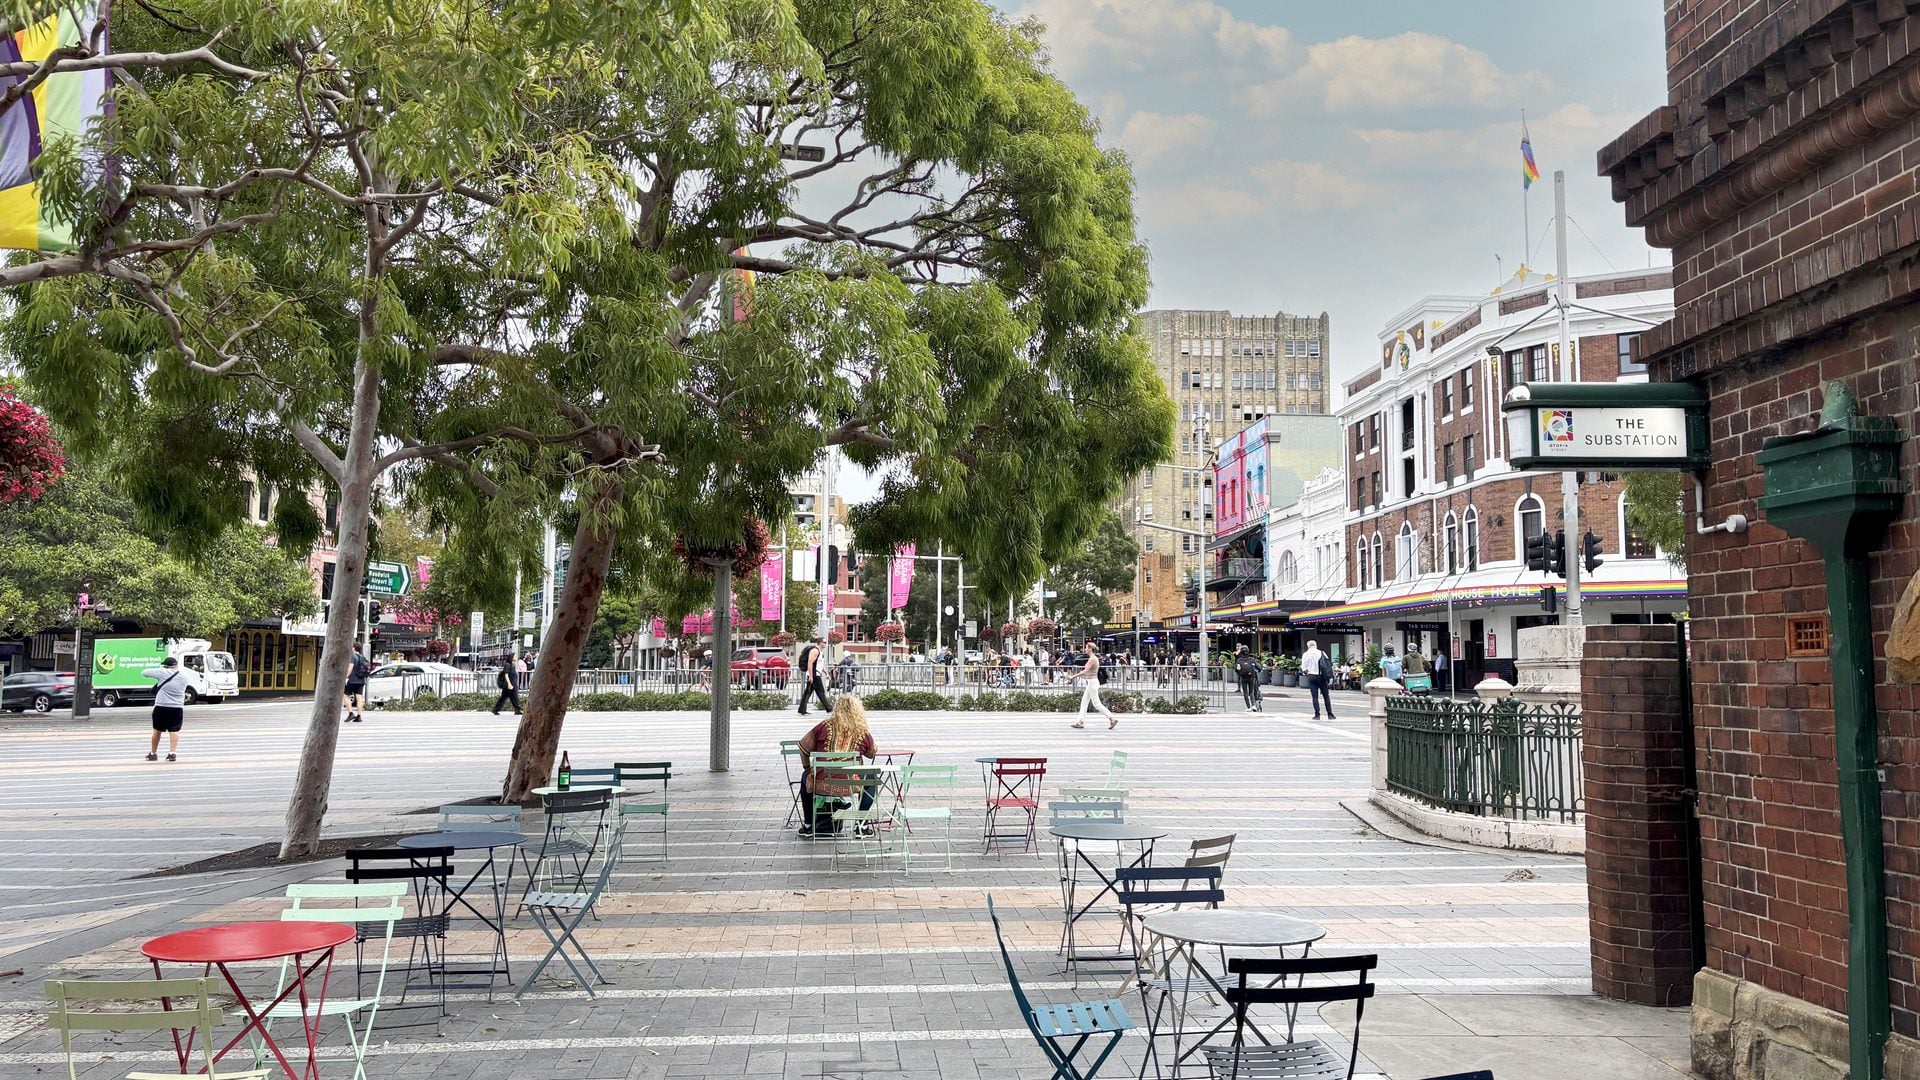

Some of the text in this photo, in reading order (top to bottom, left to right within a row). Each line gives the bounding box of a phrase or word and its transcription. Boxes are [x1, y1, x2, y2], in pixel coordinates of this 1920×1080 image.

[1615, 418, 1645, 429] THE
[1584, 434, 1678, 446] SUBSTATION
[1432, 586, 1536, 601] COURHOUSE HOTEL
